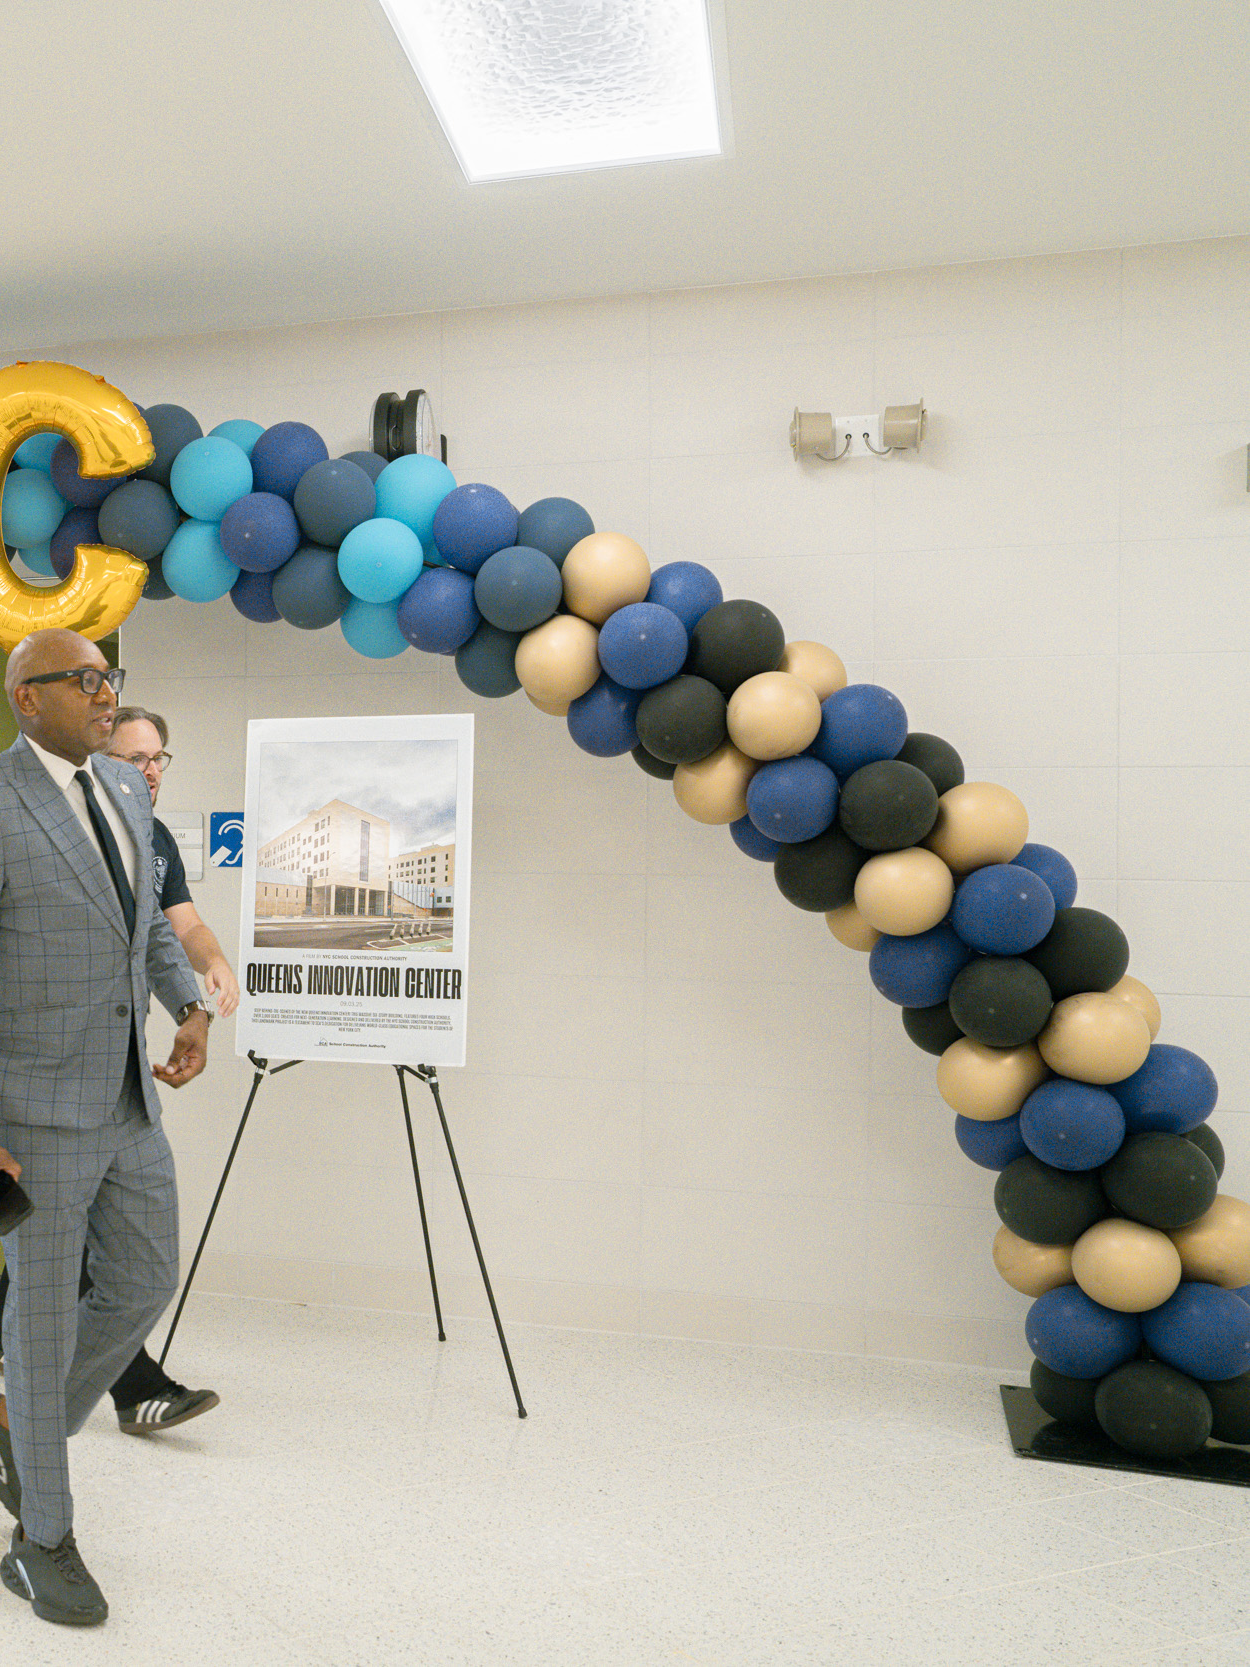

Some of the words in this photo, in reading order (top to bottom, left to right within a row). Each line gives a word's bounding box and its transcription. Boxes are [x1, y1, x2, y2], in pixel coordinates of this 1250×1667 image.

[246, 962, 303, 996] QUEENS
[307, 964, 400, 998] INNOVATION
[404, 967, 462, 1000] CENTER
